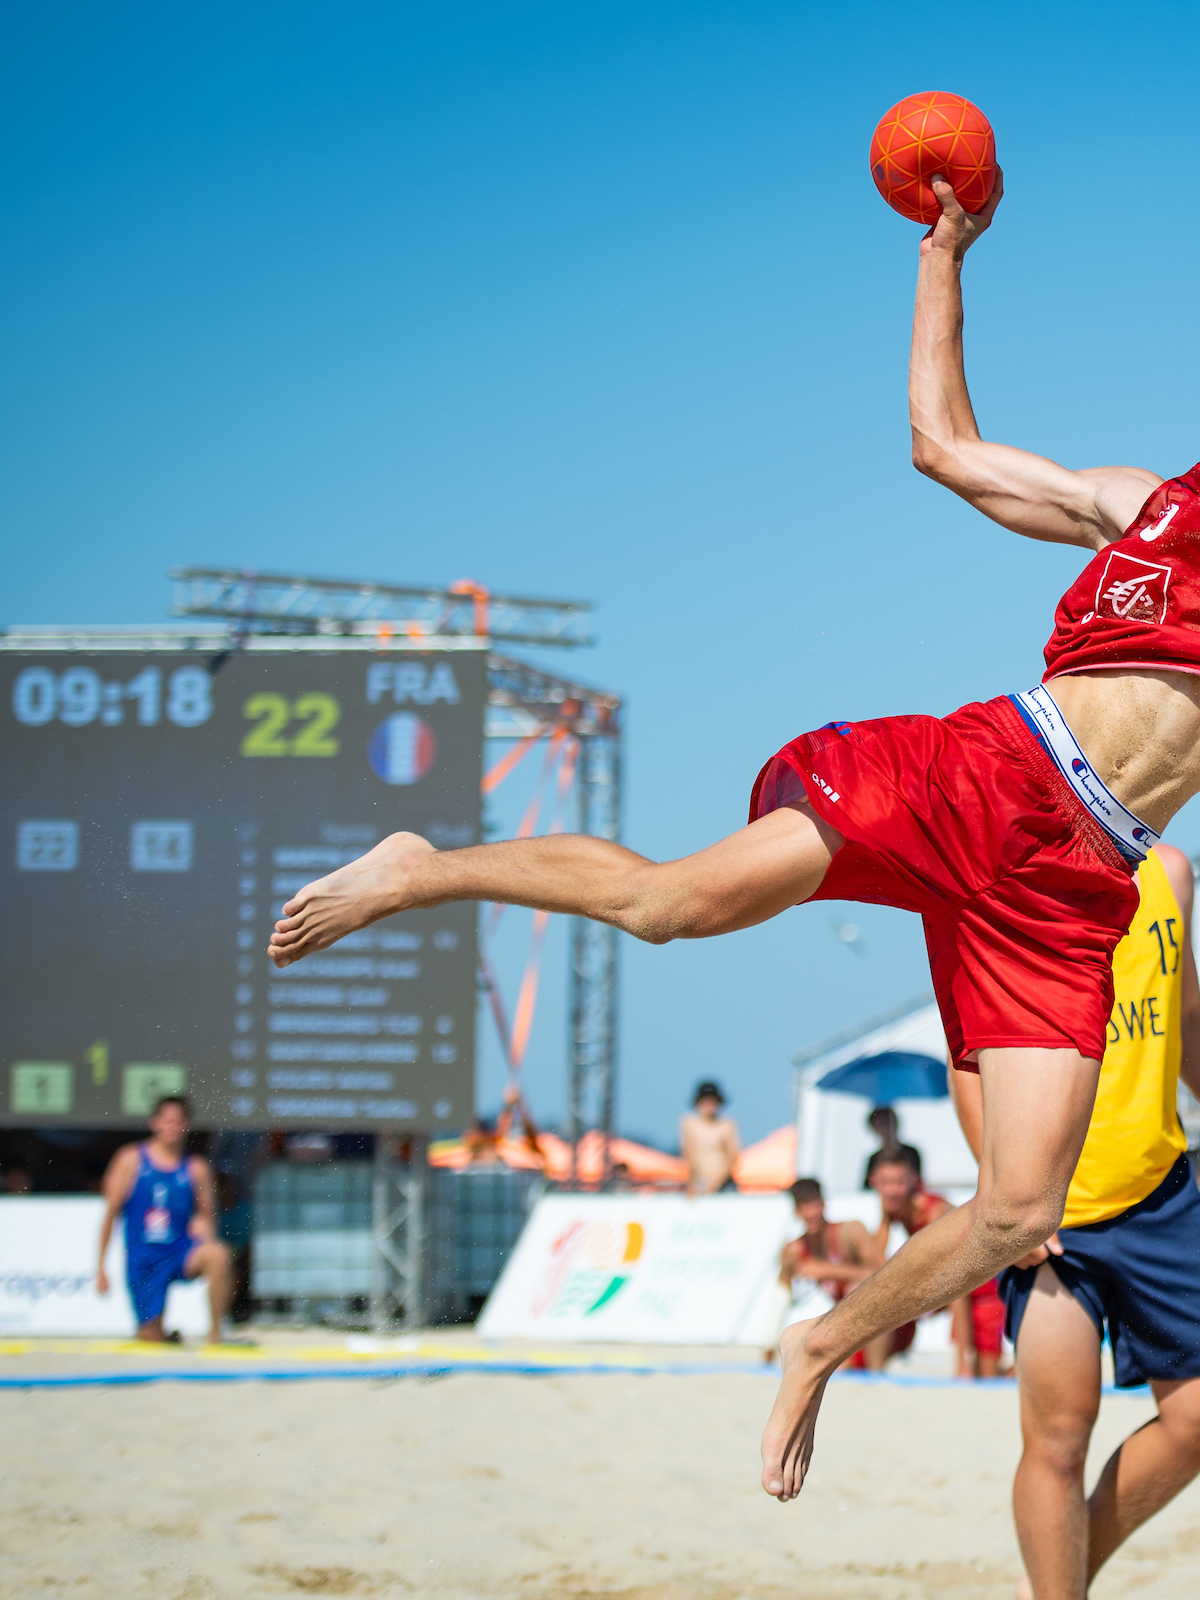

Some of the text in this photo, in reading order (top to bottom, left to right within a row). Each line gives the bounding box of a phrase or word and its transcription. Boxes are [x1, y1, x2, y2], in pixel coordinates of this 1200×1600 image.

[13, 665, 214, 728] 09:18
[365, 661, 460, 705] FRA
[1027, 686, 1056, 731] Champion
[240, 691, 341, 757] 22
[1071, 757, 1112, 816] Champion
[1148, 918, 1180, 975] 15
